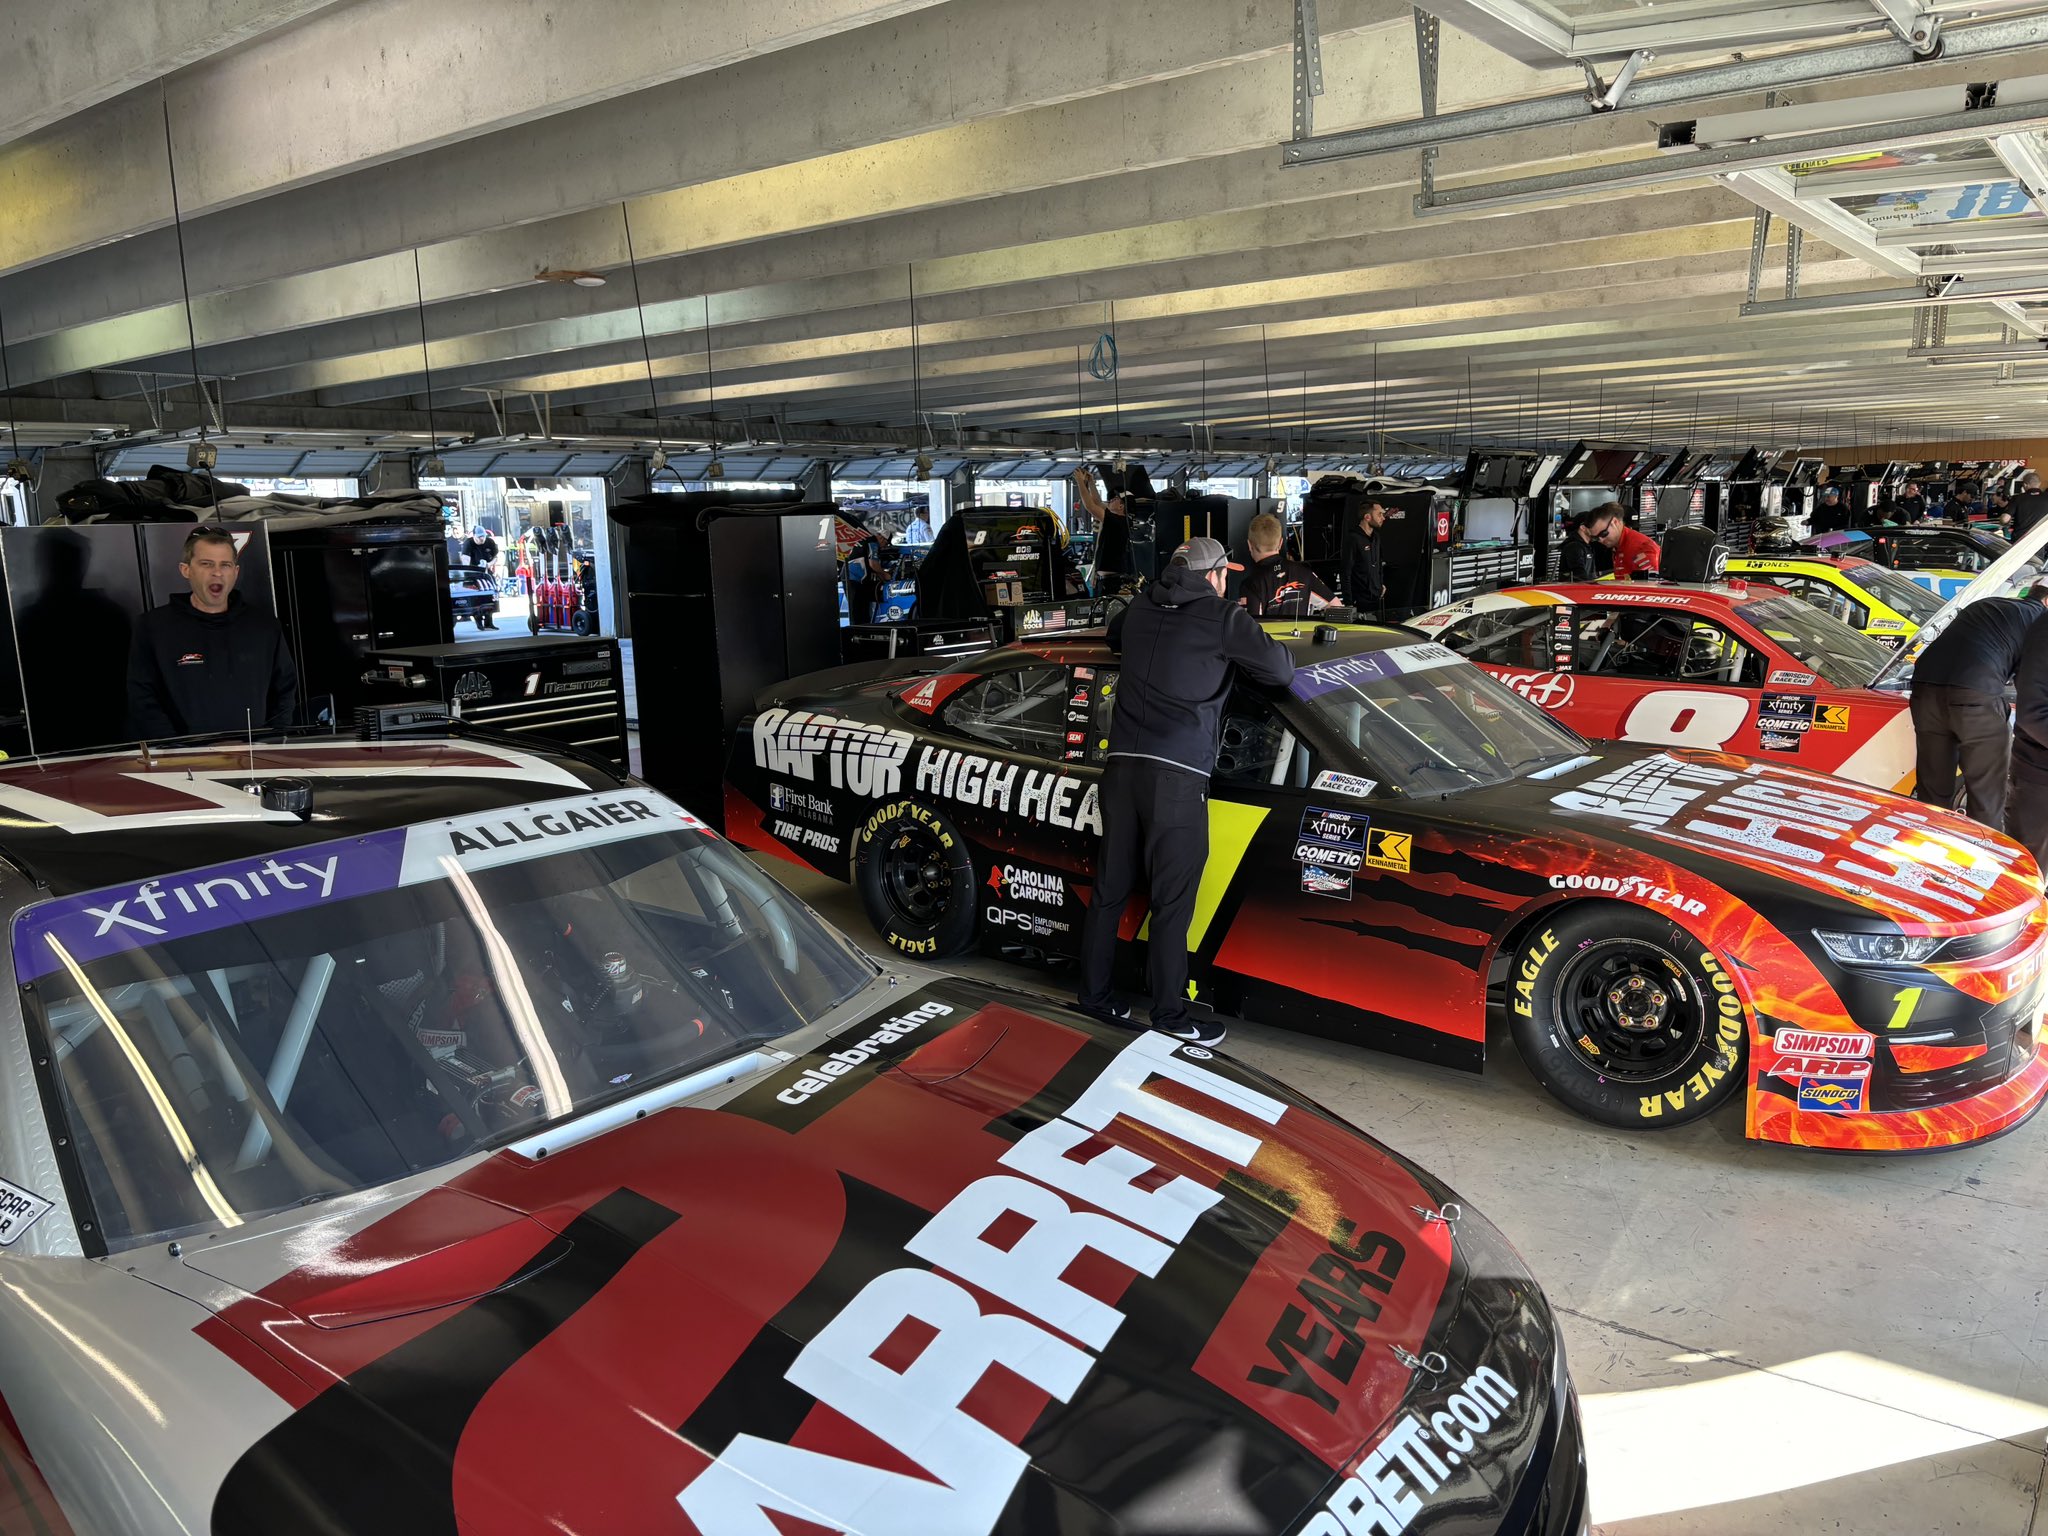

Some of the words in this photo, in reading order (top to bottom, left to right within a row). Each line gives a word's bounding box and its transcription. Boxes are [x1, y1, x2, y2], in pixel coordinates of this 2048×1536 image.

[1277, 501, 1285, 513] 9
[818, 518, 830, 540] 1
[974, 531, 987, 545] 8
[1434, 589, 1448, 609] 20
[1591, 593, 1644, 602] SAMMY
[1645, 596, 1691, 604] SMITH
[1405, 645, 1453, 663] MAYER
[1305, 658, 1384, 686] xfinity
[524, 671, 541, 696] 1
[1768, 699, 1806, 713] xfinity
[1757, 718, 1810, 731] COMETIC
[1813, 723, 1847, 731] KENNAMETAL
[753, 707, 915, 799] RAPTOR
[915, 745, 1019, 813] HIGH
[1321, 781, 1343, 791] RACE
[1343, 785, 1362, 795] CAR
[1334, 773, 1368, 788] NASCAR
[785, 786, 807, 808] First
[807, 794, 834, 816] Bank
[797, 808, 834, 826] ALABAMA
[862, 800, 954, 850] GOODYEAR
[1328, 811, 1351, 822] NASCAR
[449, 799, 662, 857] ALLGAIER
[773, 819, 801, 842] TIRE
[802, 828, 840, 854] PROS
[1311, 818, 1356, 840] xfinity
[1321, 832, 1342, 842] SERIES
[1296, 845, 1361, 866] COMETIC
[1367, 857, 1408, 871] KENNAMETAL
[1003, 864, 1065, 893] CAROLINA
[82, 856, 339, 937] xfinity
[1010, 882, 1064, 907] CARPORTS
[1549, 874, 1707, 917] GOODYEAR
[986, 906, 1032, 931] QPS
[1034, 916, 1070, 932] EMPLOYMENT
[1034, 925, 1052, 936] GROUP
[887, 931, 937, 954] EAGLE
[1514, 928, 1560, 1018] EAGLE
[1887, 987, 1923, 1029] 1
[420, 1031, 460, 1046] SIMPSON
[1640, 951, 1742, 1118] GOODYEAR
[1781, 1033, 1864, 1055] SIMPSON
[776, 1001, 954, 1105] celebrating
[1770, 1056, 1870, 1076] ARP
[1801, 1087, 1859, 1099] SUNOCO
[1246, 1218, 1407, 1416] YEARS
